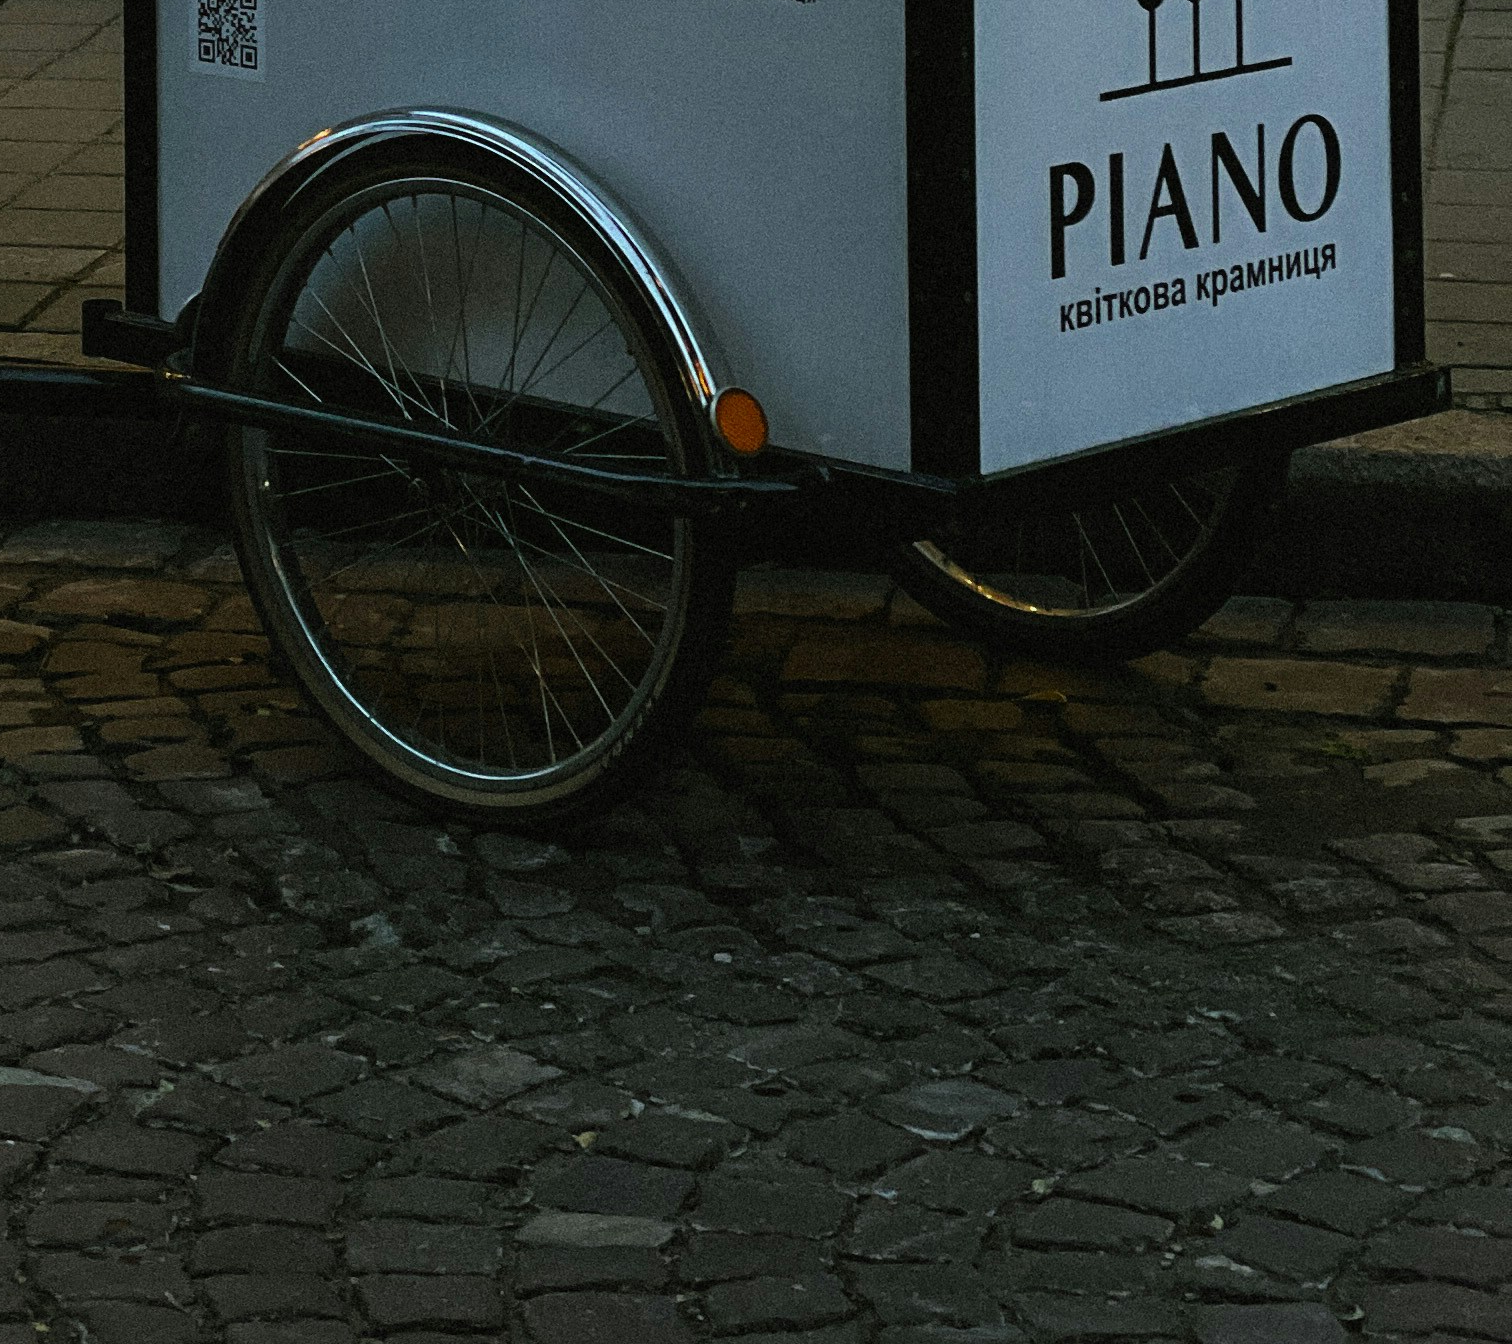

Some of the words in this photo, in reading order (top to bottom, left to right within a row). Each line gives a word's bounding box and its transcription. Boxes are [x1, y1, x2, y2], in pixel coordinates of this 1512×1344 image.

[1049, 113, 1342, 280] PIANO
[1060, 277, 1187, 332] квіткова
[1196, 243, 1337, 307] крамниця
